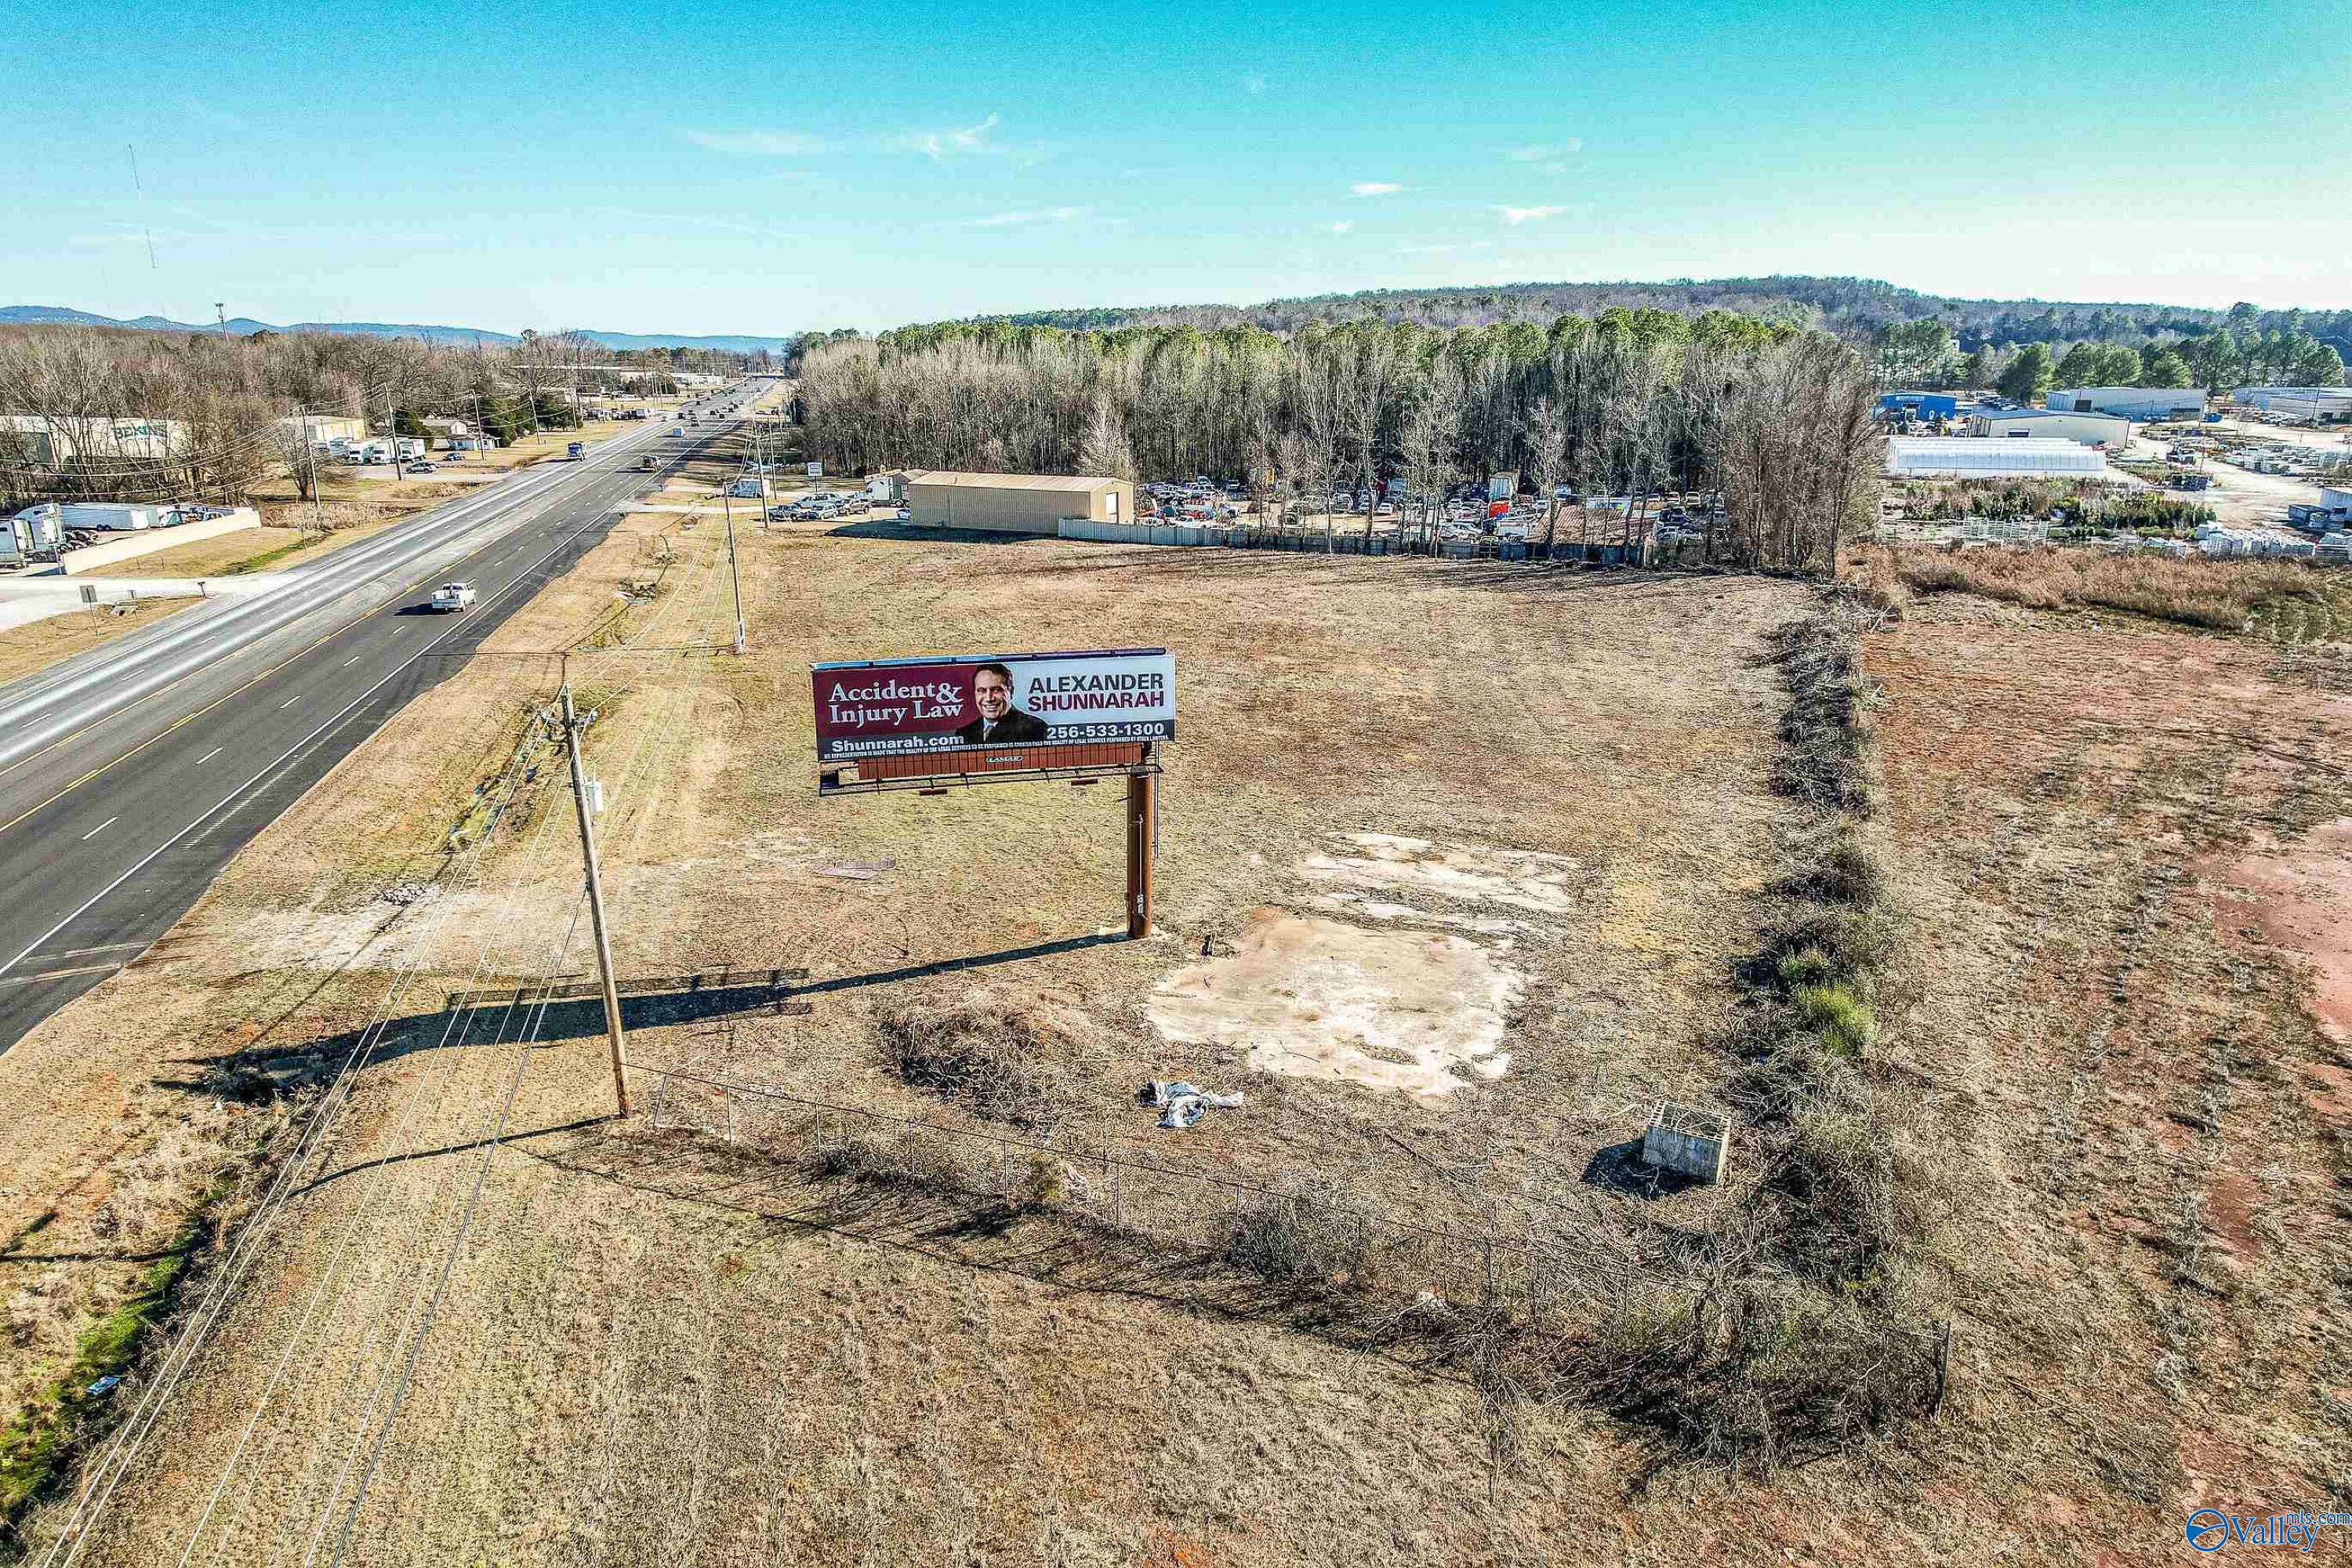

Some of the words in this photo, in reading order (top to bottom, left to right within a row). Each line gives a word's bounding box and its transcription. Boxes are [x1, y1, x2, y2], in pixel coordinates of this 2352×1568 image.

[111, 425, 167, 440] BEK
[1029, 673, 1163, 693] ALEXANDER
[1028, 691, 1164, 712] SHUNNARAH
[829, 703, 908, 728] Injury
[913, 700, 964, 720] Law
[1046, 723, 1165, 740] 256-533-1300
[831, 735, 964, 753] Shunnarah.com
